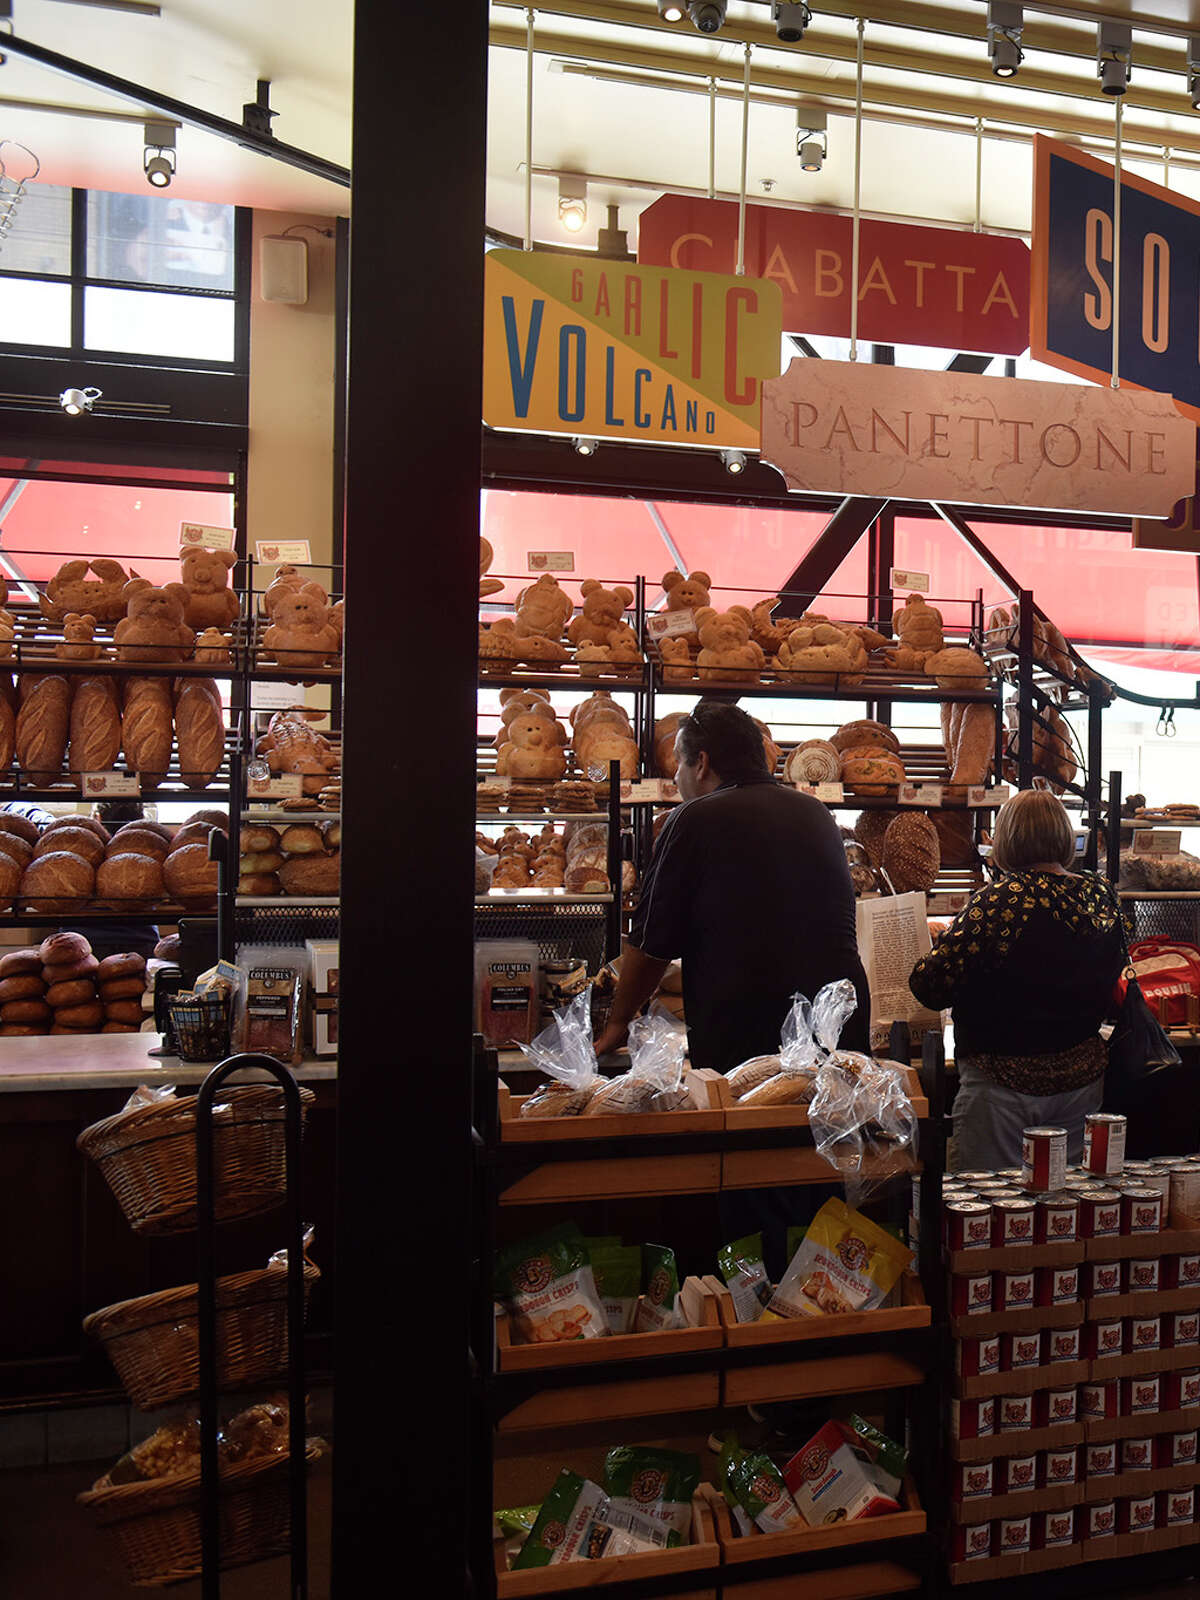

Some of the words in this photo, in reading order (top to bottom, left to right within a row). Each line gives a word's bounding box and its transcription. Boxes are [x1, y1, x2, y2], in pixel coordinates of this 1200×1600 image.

[502, 295, 716, 435] VOLCANO
[570, 268, 761, 405] GARLIC
[789, 400, 1169, 477] PANETTONE
